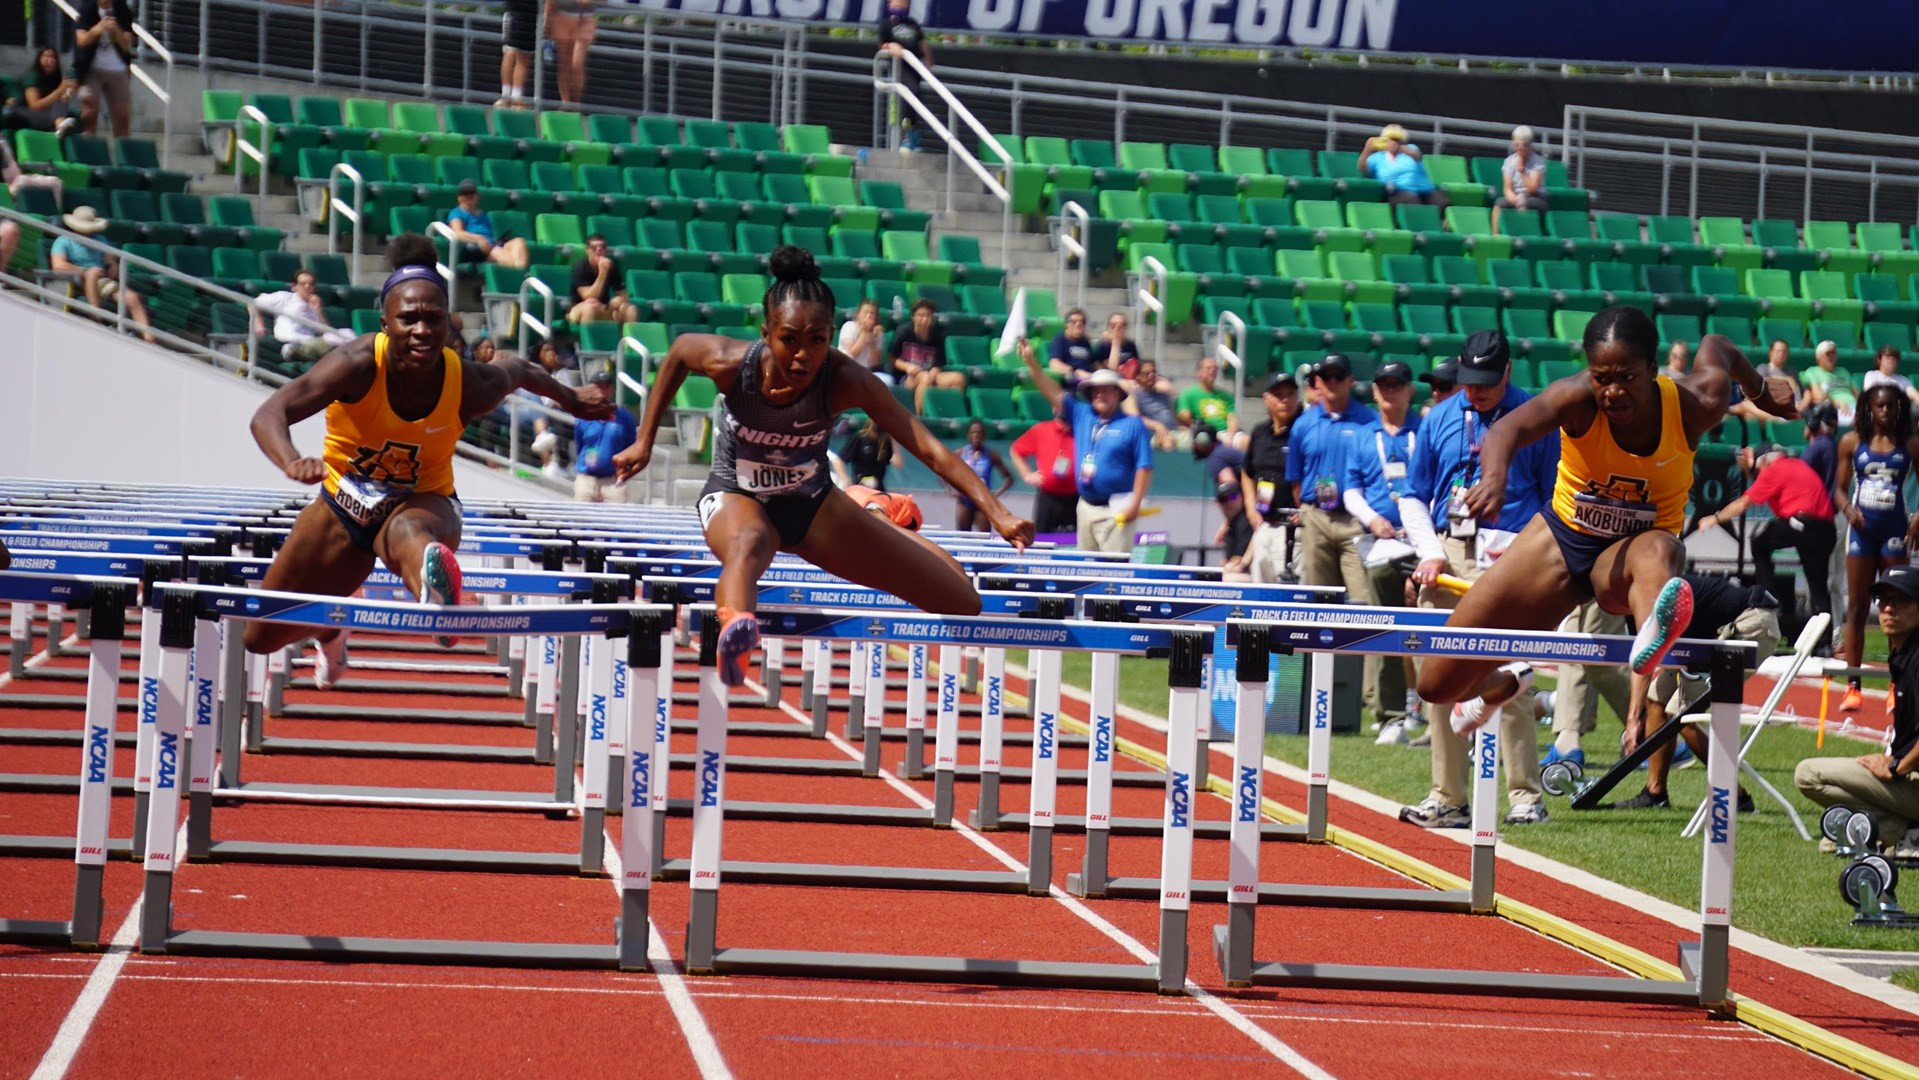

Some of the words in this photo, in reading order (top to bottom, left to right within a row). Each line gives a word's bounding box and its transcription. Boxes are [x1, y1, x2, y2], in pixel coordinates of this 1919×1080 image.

[725, 413, 827, 448] KNIGHTS
[336, 489, 392, 520] ROBINSO
[14, 537, 36, 546] FIELD
[39, 538, 109, 550] CHAMPIONSHIPS
[782, 571, 802, 581] FIELD
[1028, 566, 1050, 574] TRACK
[1057, 567, 1075, 575] FIELD
[1076, 568, 1135, 578] CHAMPIONSHIPS
[216, 599, 235, 607] GILL
[810, 591, 840, 603] TRACK
[841, 593, 848, 603] &
[849, 593, 873, 604] FIELD
[1120, 585, 1146, 595] TRACK
[1147, 586, 1153, 595] &
[1153, 587, 1174, 597] FIELD
[1175, 588, 1243, 599] CHAMPIONSHIPS
[353, 610, 389, 625] TRACK
[391, 613, 400, 626] &
[401, 614, 433, 628] FIELD
[435, 616, 530, 629] CHAMPIONSHIPS
[893, 623, 929, 637] TRACK
[930, 625, 939, 637] &
[940, 624, 971, 638] FIELD
[973, 627, 1067, 642] CHAMPIONSHIPS
[1251, 609, 1280, 620] TRACK
[1281, 611, 1289, 621] &
[1290, 611, 1315, 622] FIELD
[1316, 612, 1395, 625] CHAMPIONSHIPS
[1130, 634, 1149, 642] GILL
[1290, 632, 1309, 640] GILL
[1430, 637, 1466, 650] TRACK
[1468, 638, 1477, 650] &
[1478, 639, 1509, 652] FIELD
[1511, 640, 1607, 657] CHAMPIONSHIPS
[871, 644, 882, 677] NCAA
[912, 646, 925, 679] NCAA
[613, 659, 626, 698] NCAA
[943, 673, 955, 712] NCAA
[142, 677, 157, 723] NCAA
[197, 678, 213, 725] NCAA
[988, 676, 1000, 715] NCAA
[1315, 689, 1328, 728] NCAA
[590, 694, 606, 740] NCAA
[1039, 712, 1054, 758] NCAA
[1095, 715, 1110, 761] NCAA
[88, 725, 108, 783] NCAA
[157, 731, 177, 788] NCAA
[1481, 732, 1496, 779] NCAA
[631, 751, 649, 807] NCAA
[702, 750, 719, 806] NCAA
[1239, 765, 1257, 821] NCAA
[1171, 771, 1189, 827] NCAA
[1711, 786, 1730, 843] NCAA
[80, 846, 102, 855] GILL
[149, 852, 171, 860] GILL
[695, 871, 716, 879] GILL
[1233, 885, 1254, 893] GILL
[1165, 891, 1186, 899] GILL
[1705, 906, 1727, 915] GILL
